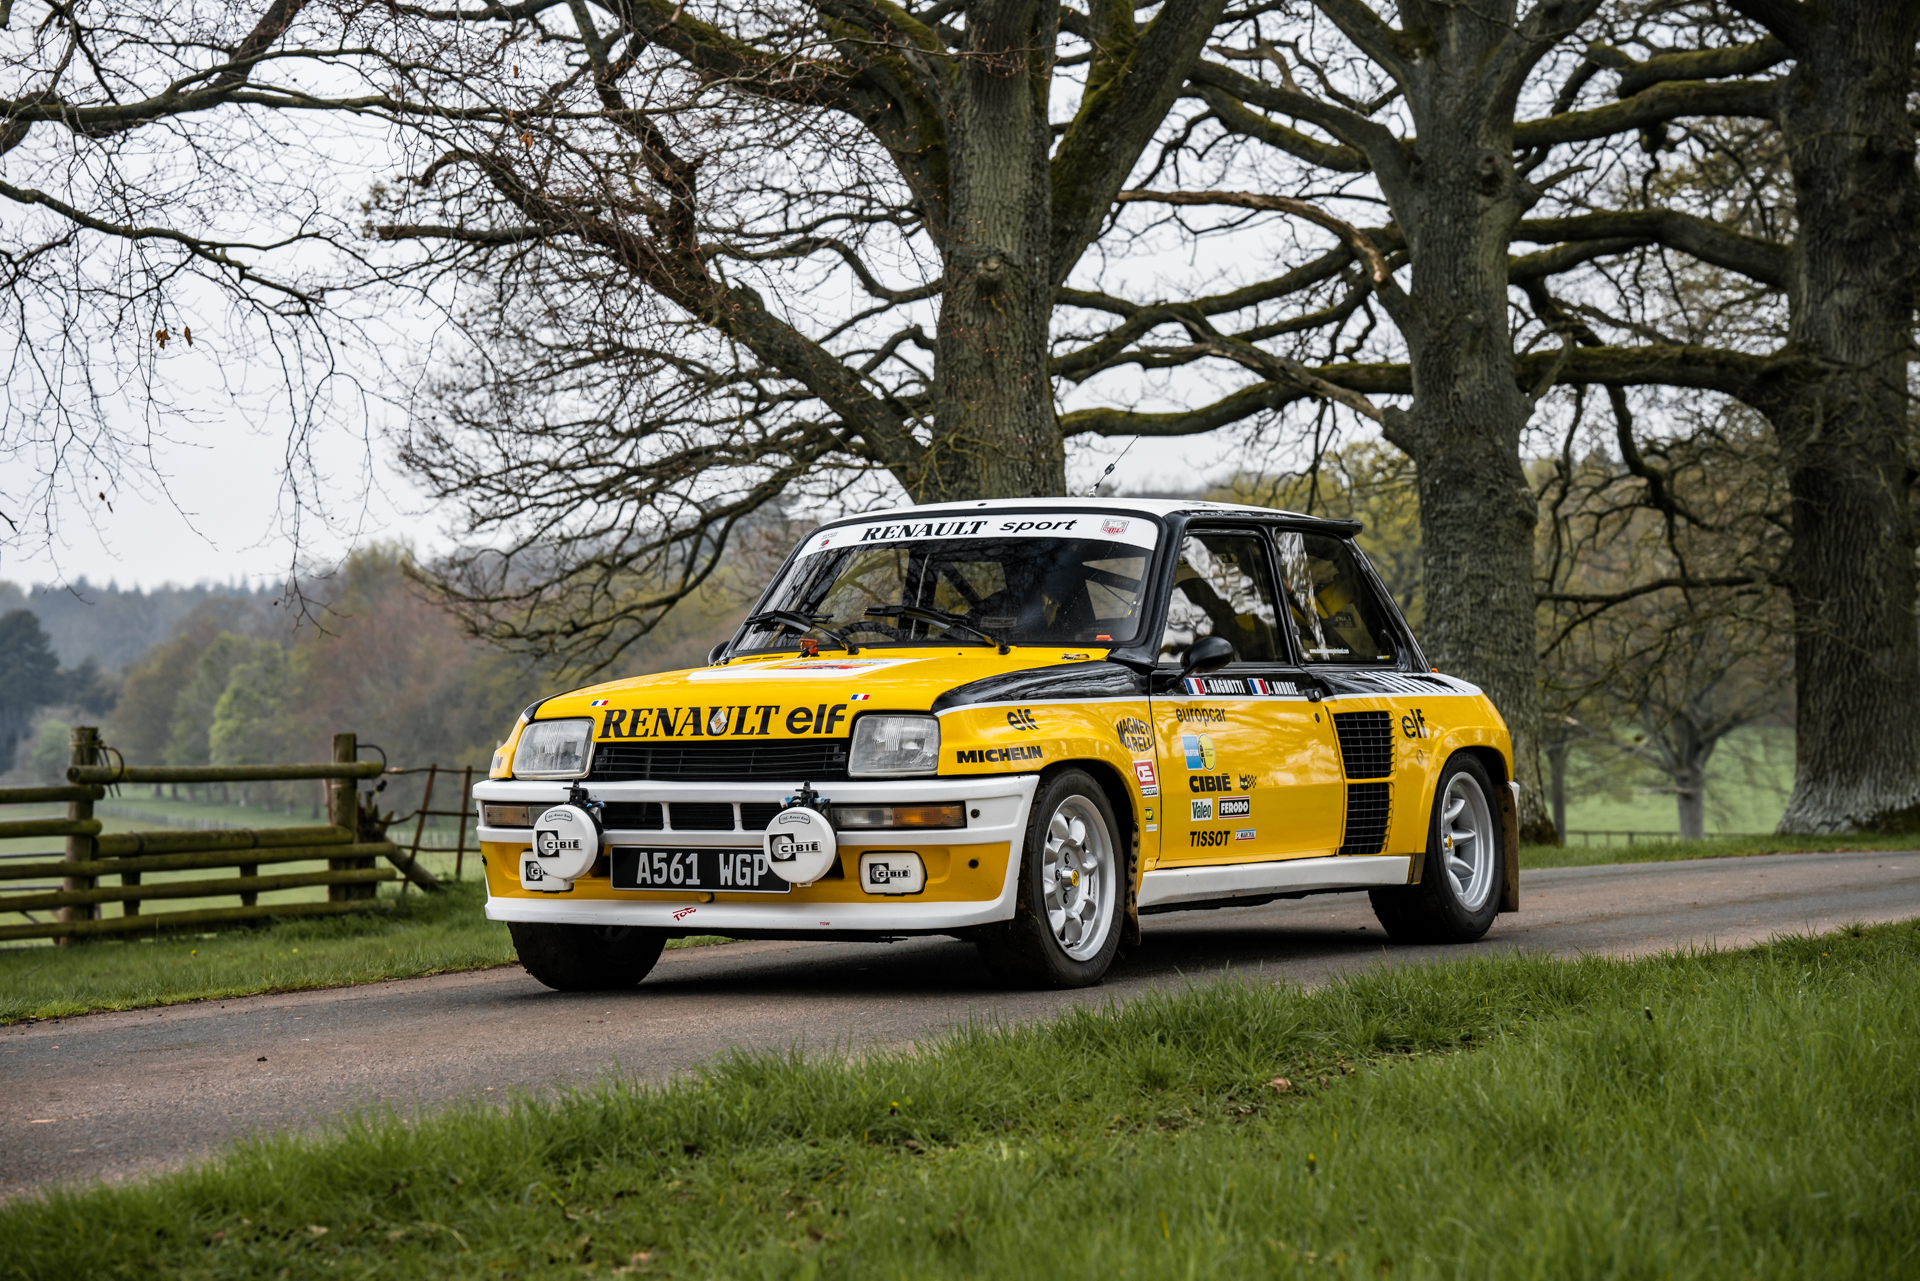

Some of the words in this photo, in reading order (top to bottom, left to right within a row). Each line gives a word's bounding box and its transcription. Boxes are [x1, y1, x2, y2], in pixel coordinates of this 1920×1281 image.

[860, 521, 987, 541] RENAULT
[999, 519, 1078, 535] sport
[598, 705, 780, 739] RENAULT
[786, 703, 847, 735] elf
[1007, 709, 1039, 731] elf
[1175, 708, 1226, 727] europcar
[1401, 708, 1427, 739] elf
[956, 745, 1043, 764] MICHELIN
[1192, 801, 1212, 819] Valeo
[1220, 801, 1249, 814] FERODO
[1190, 830, 1230, 847] TISSOT
[636, 852, 700, 886] A561
[718, 853, 768, 886] WGP
